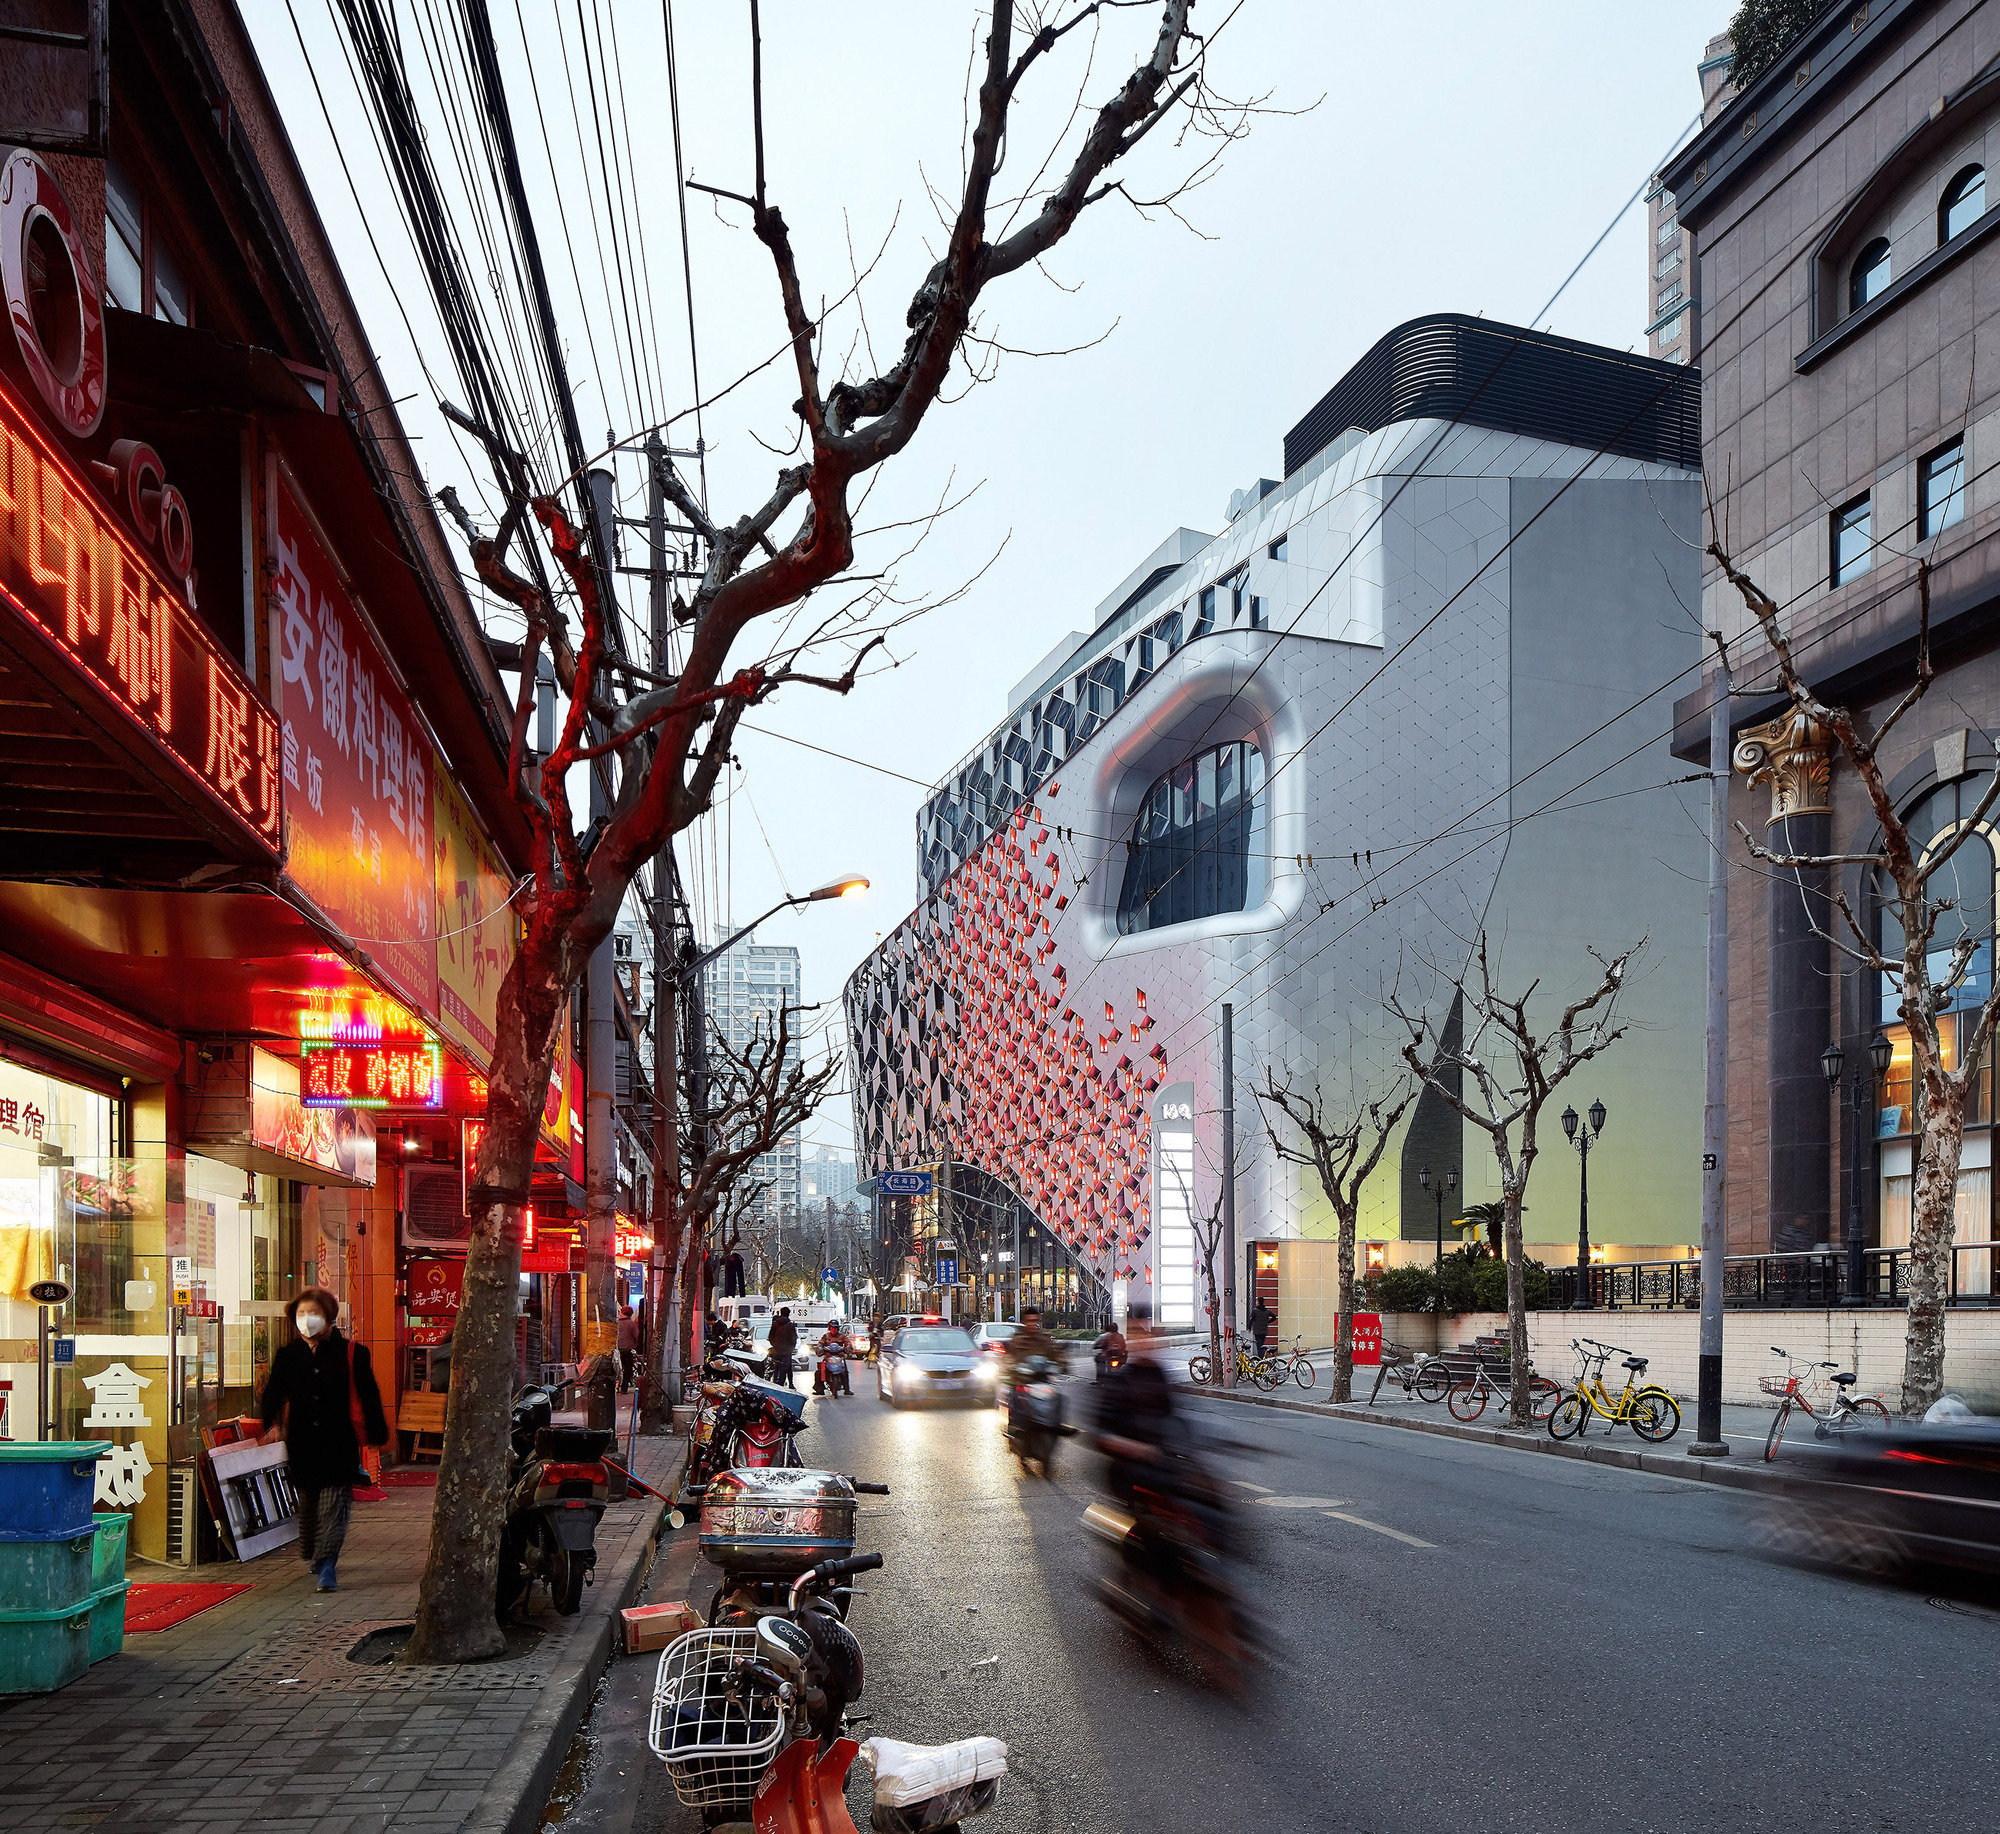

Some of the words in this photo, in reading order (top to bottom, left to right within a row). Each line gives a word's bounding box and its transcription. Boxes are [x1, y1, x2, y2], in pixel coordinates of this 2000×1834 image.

[278, 534, 427, 869] 安徽料理馆
[281, 718, 324, 818] 盒饭
[309, 1049, 352, 1098] 凉皮
[366, 1050, 433, 1098] 砂锅饭
[176, 1260, 188, 1271] 推
